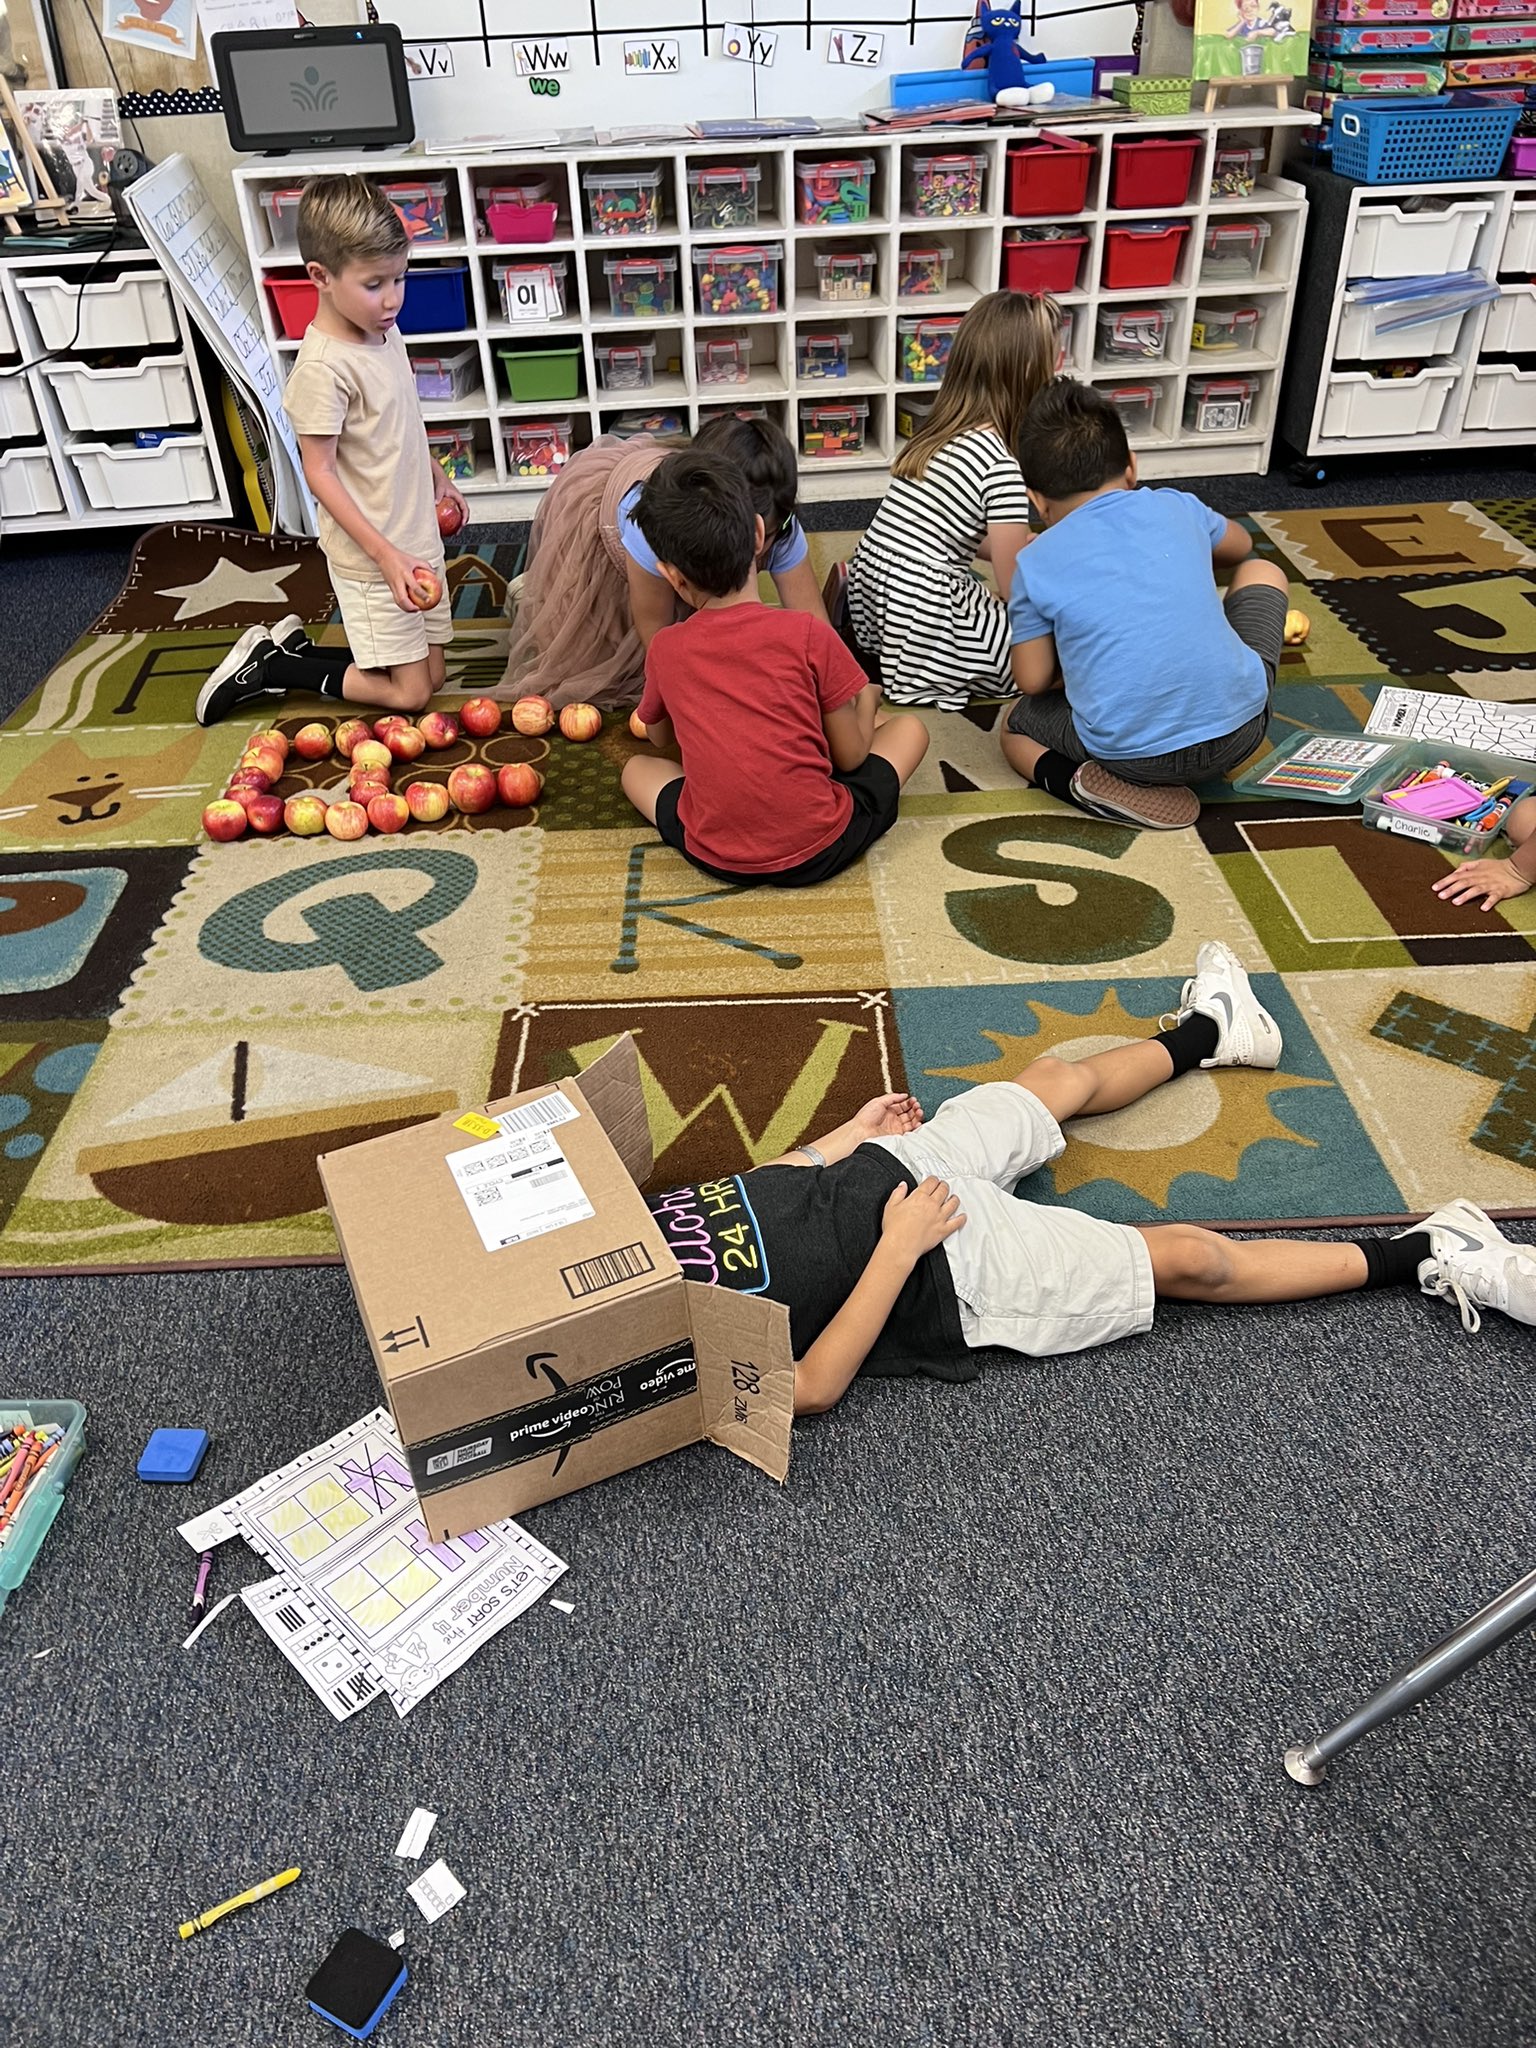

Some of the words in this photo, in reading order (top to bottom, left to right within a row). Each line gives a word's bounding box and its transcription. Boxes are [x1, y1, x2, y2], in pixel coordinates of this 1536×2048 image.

[419, 48, 449, 75] Vv
[523, 44, 568, 71] Ww
[652, 43, 677, 71] Xx
[747, 29, 773, 64] Yy
[851, 35, 878, 64] Zz
[529, 76, 561, 97] we
[1321, 514, 1476, 568] E
[1394, 820, 1430, 838] Charlie
[940, 813, 1175, 966] S
[197, 847, 479, 993] Q
[610, 840, 803, 974] K
[718, 1222, 758, 1271] 24
[585, 1375, 623, 1400] POW
[639, 1373, 675, 1391] video
[730, 1359, 761, 1395] 128
[588, 1389, 625, 1416] RIN
[509, 1419, 550, 1442] prime
[551, 1405, 589, 1425] video
[450, 1554, 525, 1621] Number
[466, 1596, 501, 1628] SORT
[442, 1627, 466, 1645] the
